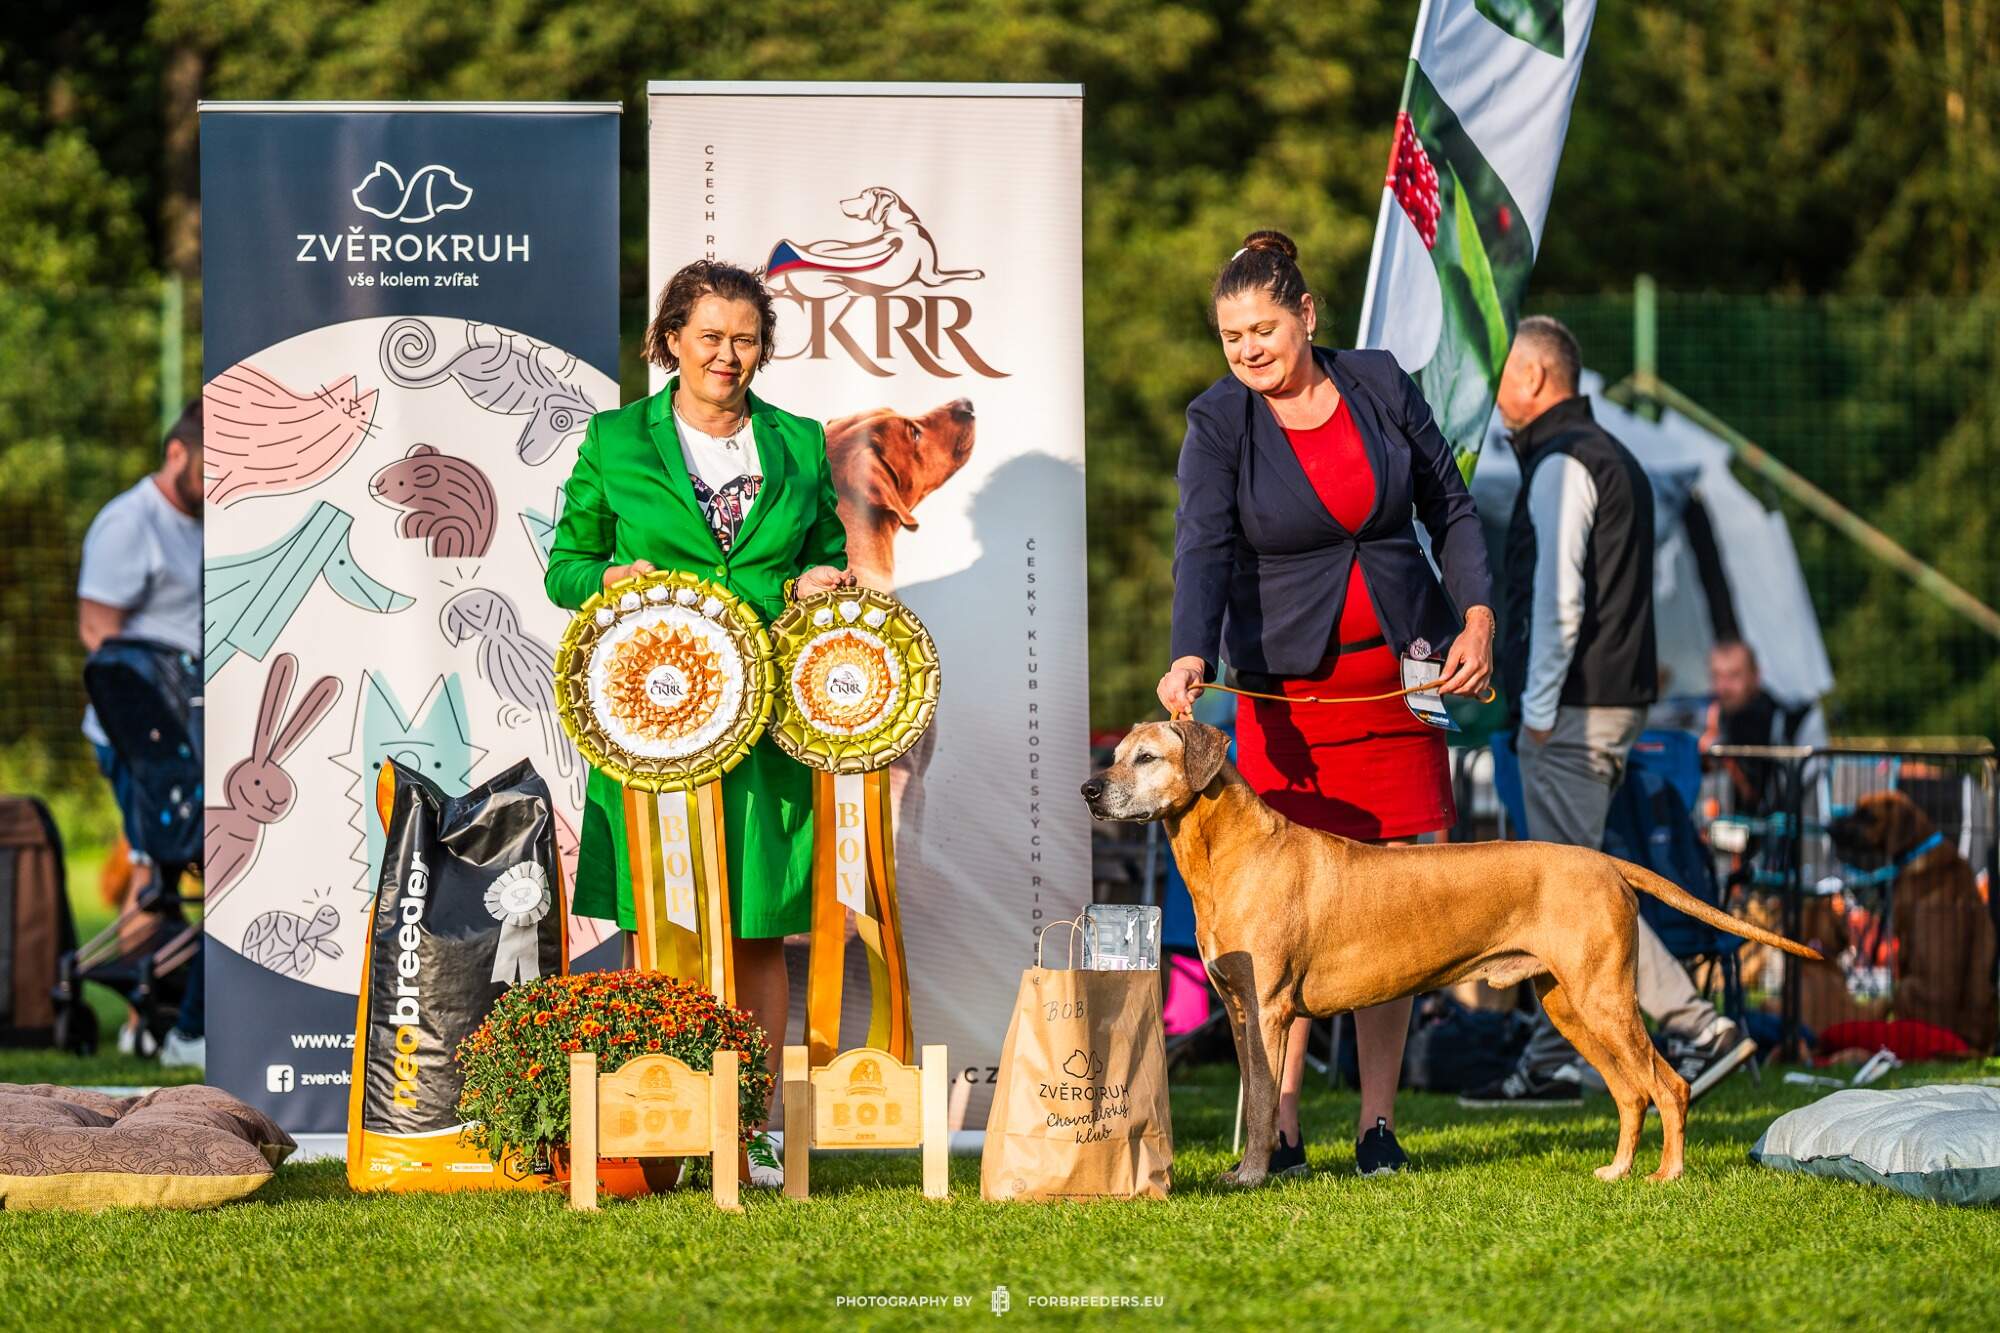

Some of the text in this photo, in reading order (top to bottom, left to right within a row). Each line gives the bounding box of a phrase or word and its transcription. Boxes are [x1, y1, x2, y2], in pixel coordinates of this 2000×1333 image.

[704, 144, 717, 265] CZECH RH
[296, 225, 530, 263] ZVĚROKRUH
[347, 272, 480, 287] vše kolem zvířat
[1026, 537, 1037, 616] ČESKÝ
[1027, 630, 1038, 690] KLUB
[838, 802, 860, 897] BOV
[389, 851, 430, 1109] neobreeder
[1043, 1000, 1084, 1022] BOB
[832, 1102, 903, 1127] BOB
